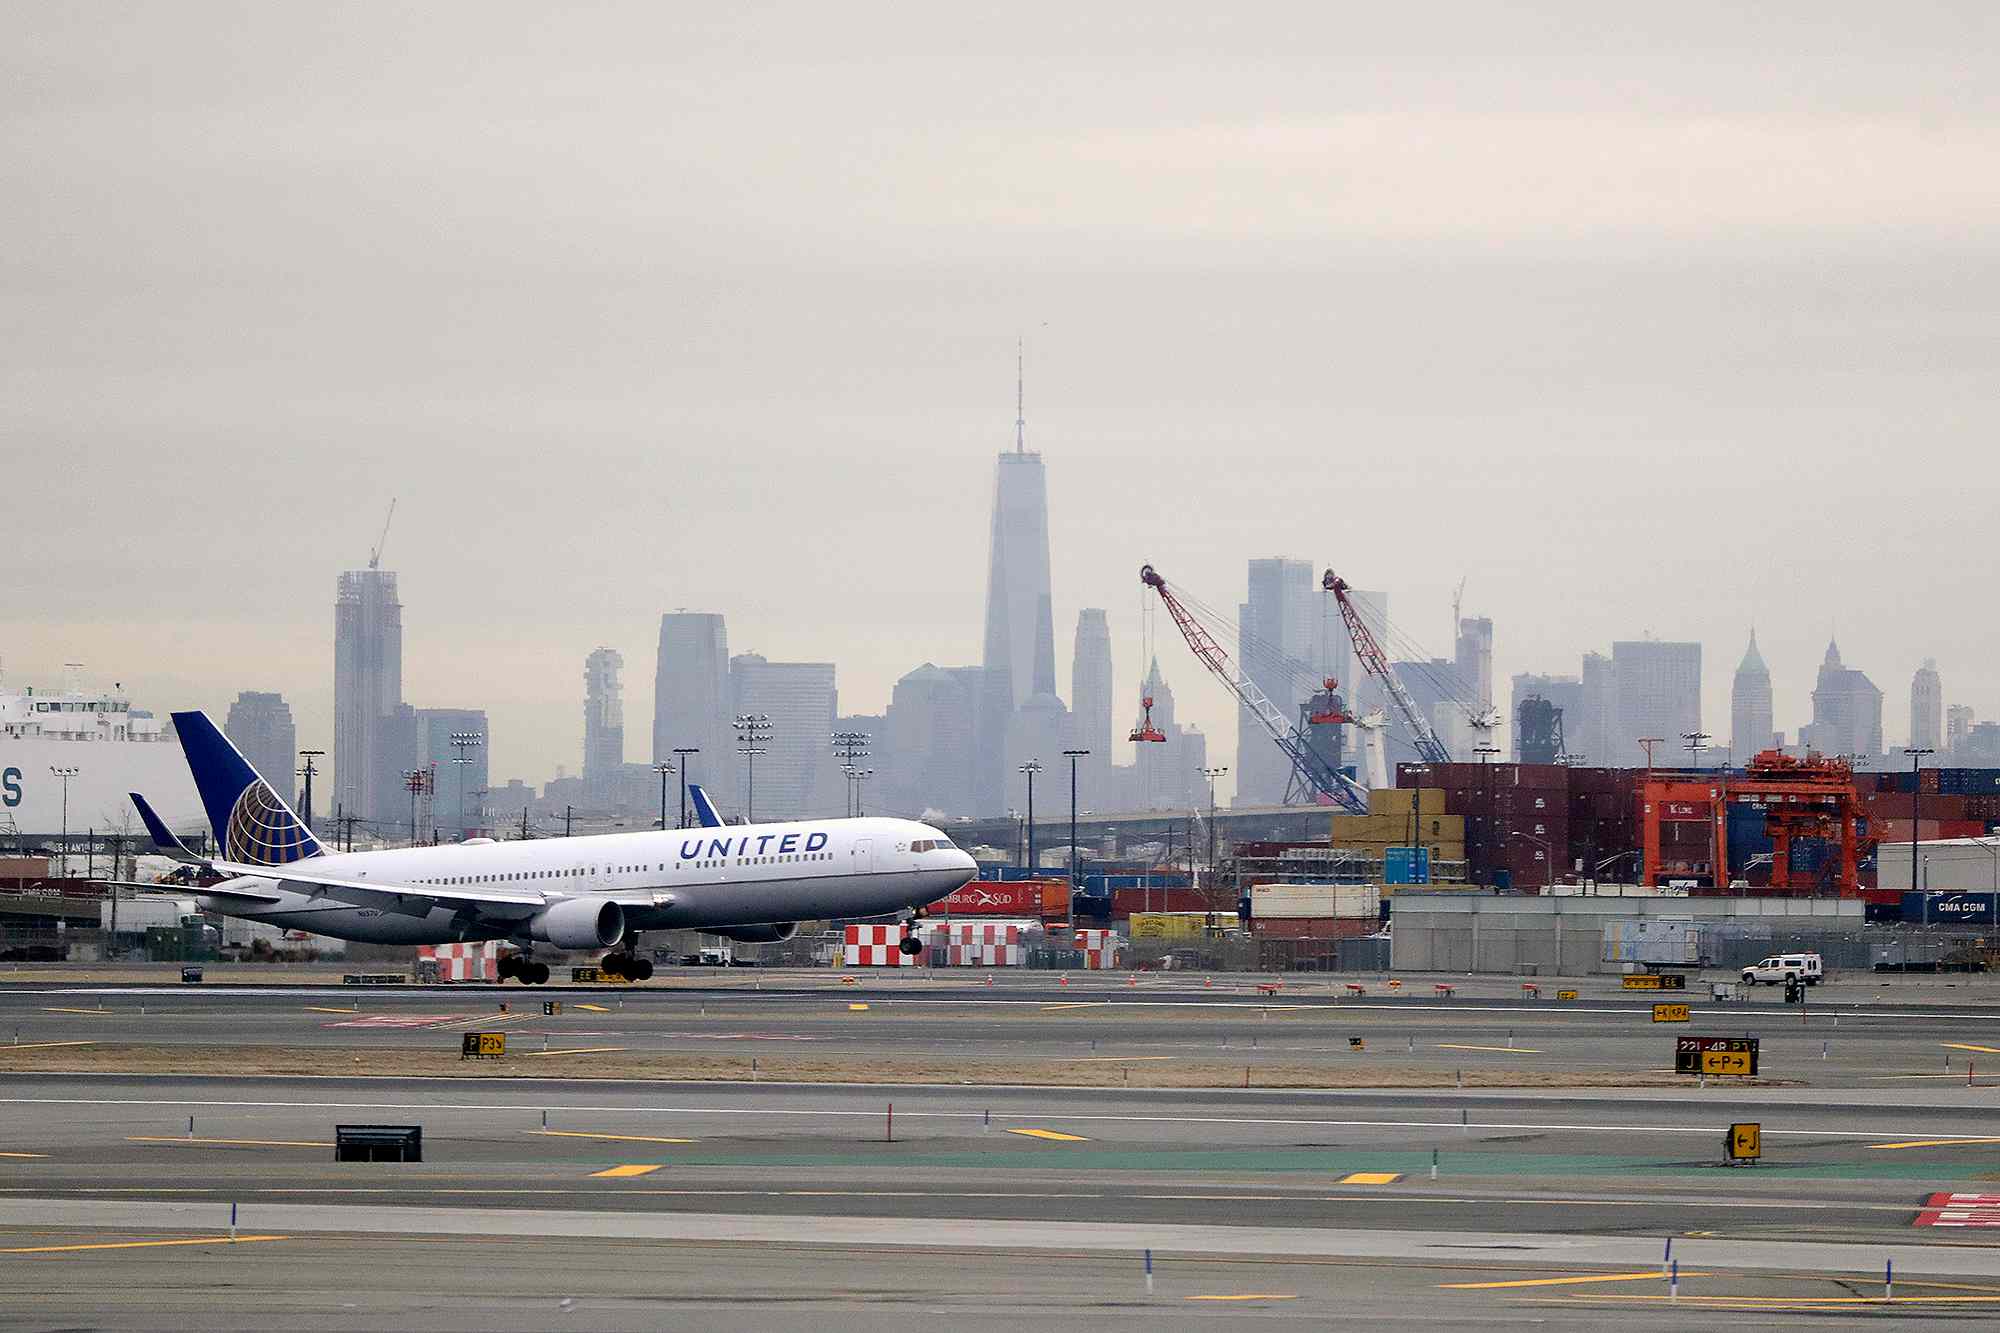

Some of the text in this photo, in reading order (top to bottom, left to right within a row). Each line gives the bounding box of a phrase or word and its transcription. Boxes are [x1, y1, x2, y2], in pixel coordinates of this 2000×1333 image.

[2, 767, 22, 807] S
[680, 832, 828, 860] UNITED
[1938, 903, 1985, 912] CMA CGM
[470, 1037, 477, 1050] P
[482, 1037, 495, 1050] P3
[1686, 1055, 1694, 1069] J
[1721, 1056, 1730, 1070] P
[1749, 1131, 1757, 1150] J
